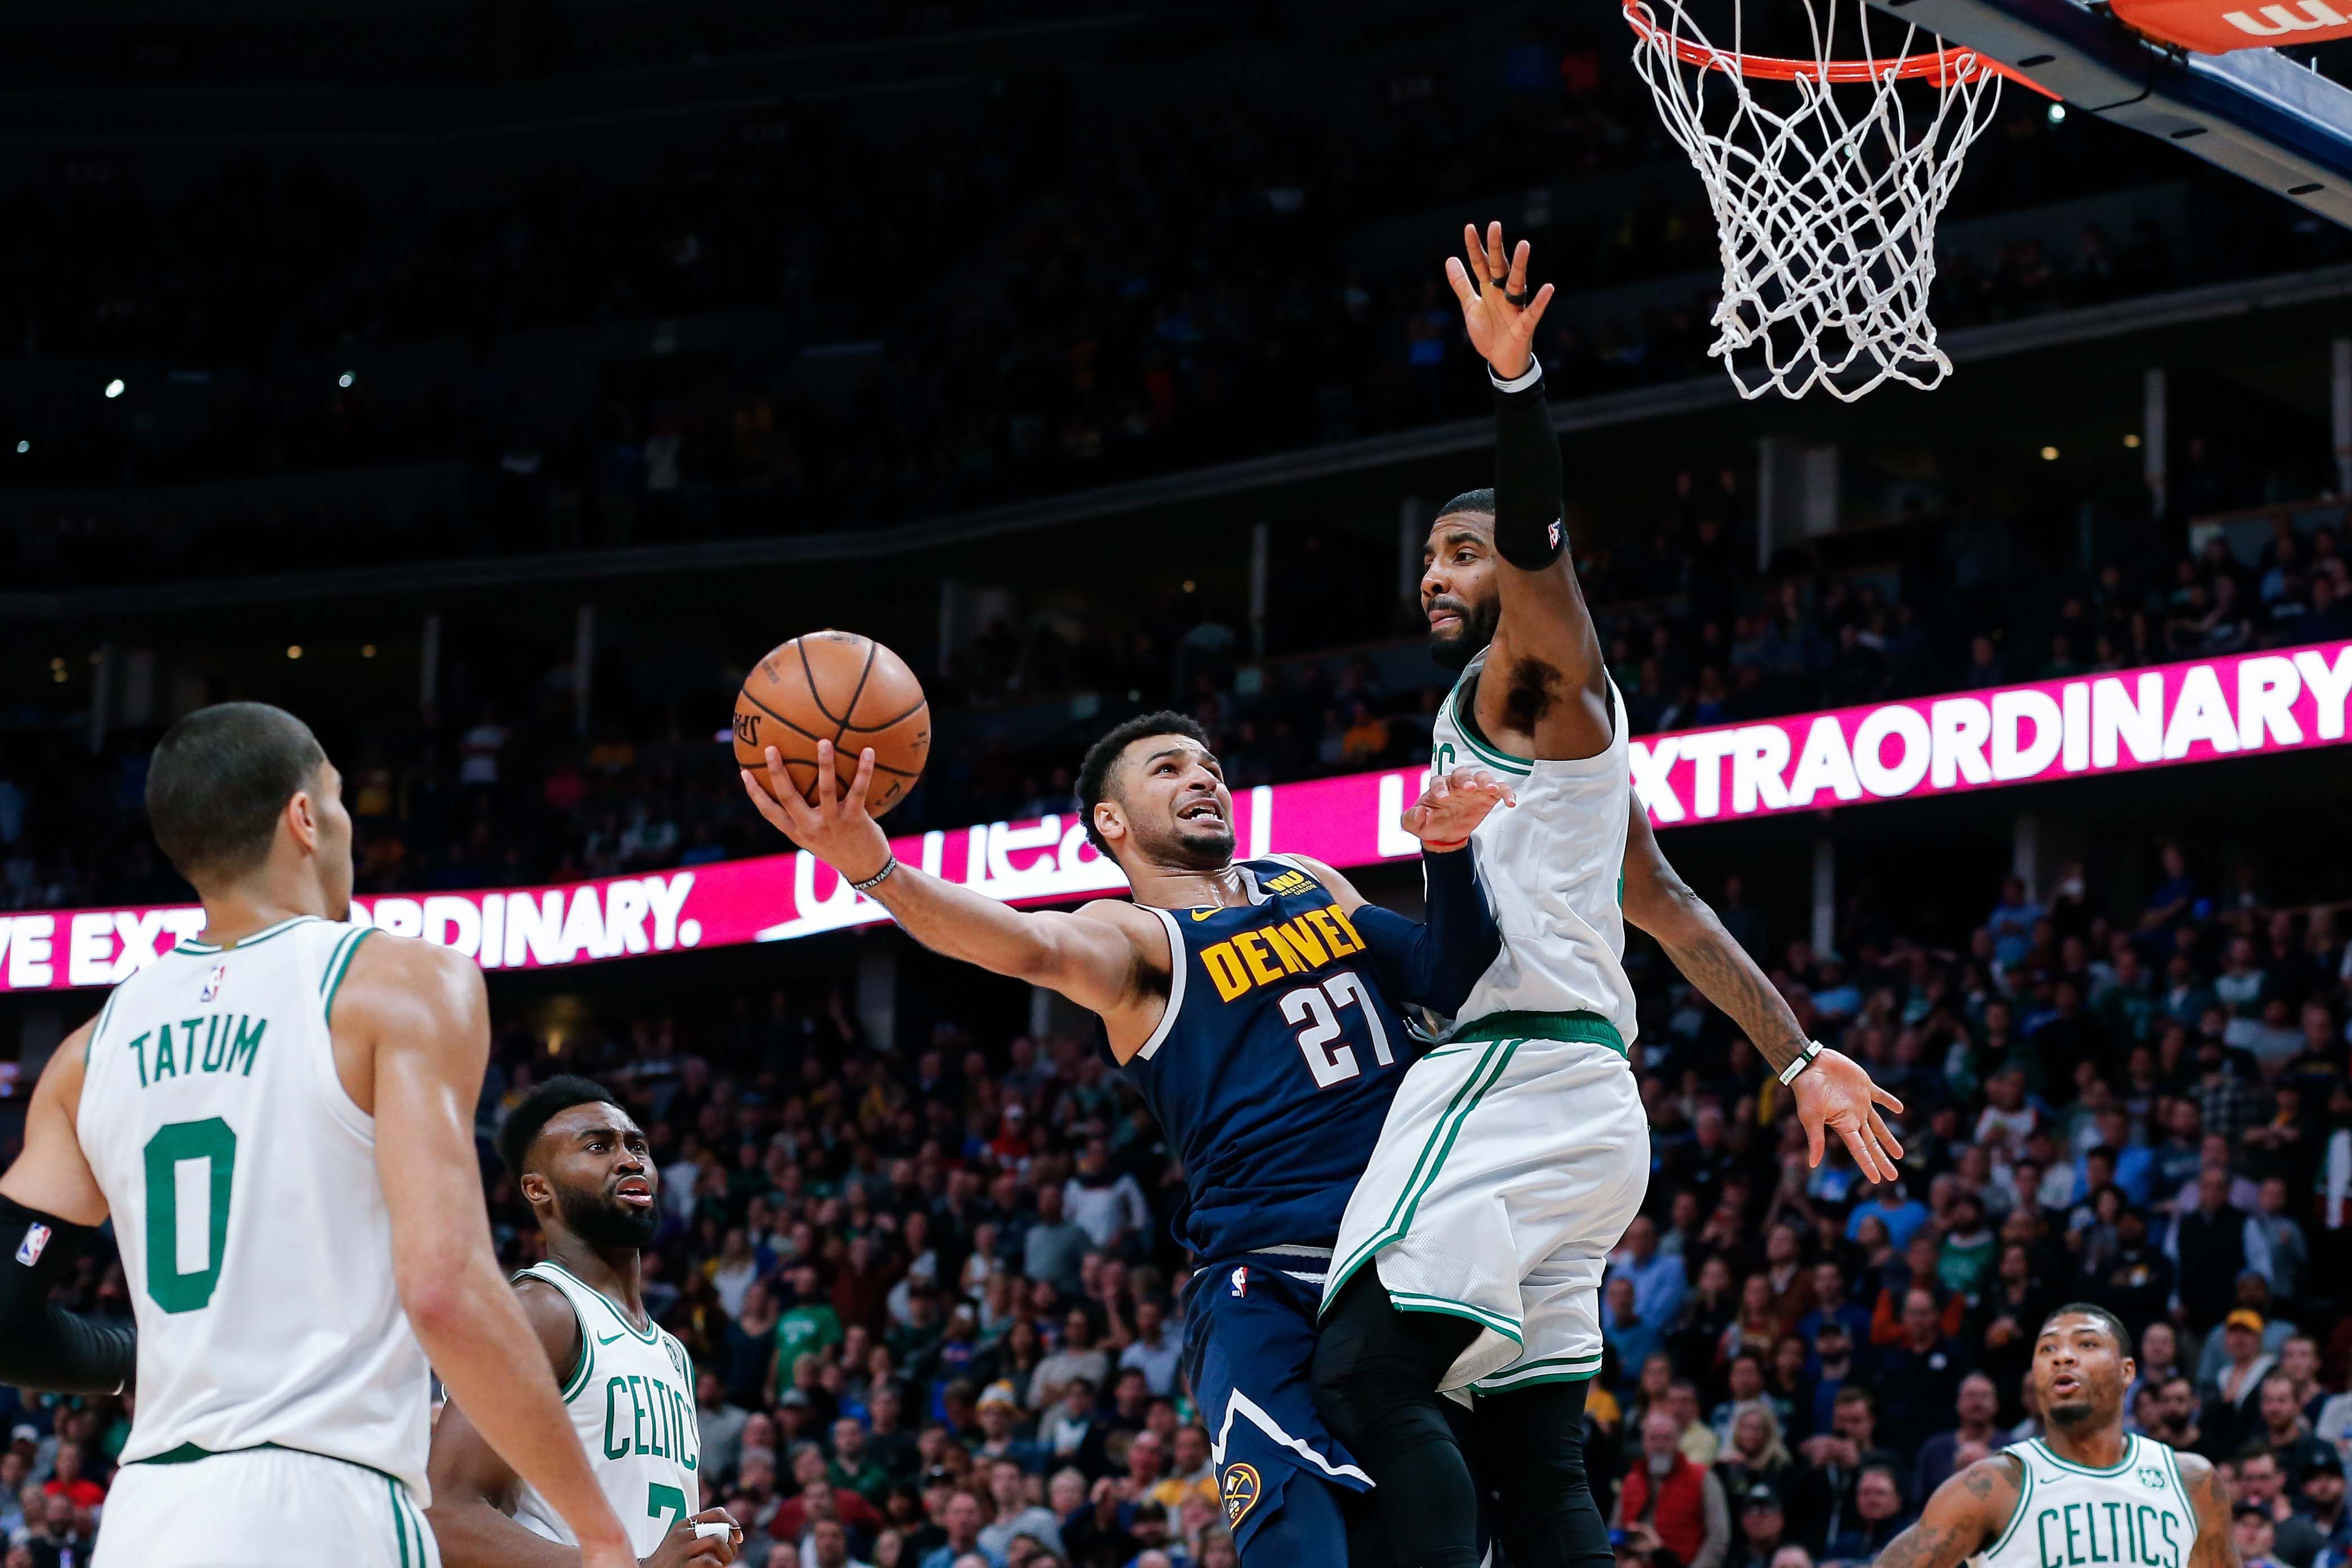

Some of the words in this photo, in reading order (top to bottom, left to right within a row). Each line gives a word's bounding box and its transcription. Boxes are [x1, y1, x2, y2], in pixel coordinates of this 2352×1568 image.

[1629, 647, 2352, 823] XTRAORDINARY
[1263, 870, 1304, 891] WU
[1279, 880, 1312, 896] WESTERN
[1294, 884, 1317, 895] UNION
[129, 1014, 267, 1088] TATUM
[1278, 971, 1395, 1089] 27
[143, 1116, 237, 1314] 0
[2038, 1502, 2179, 1568] CELTICS
